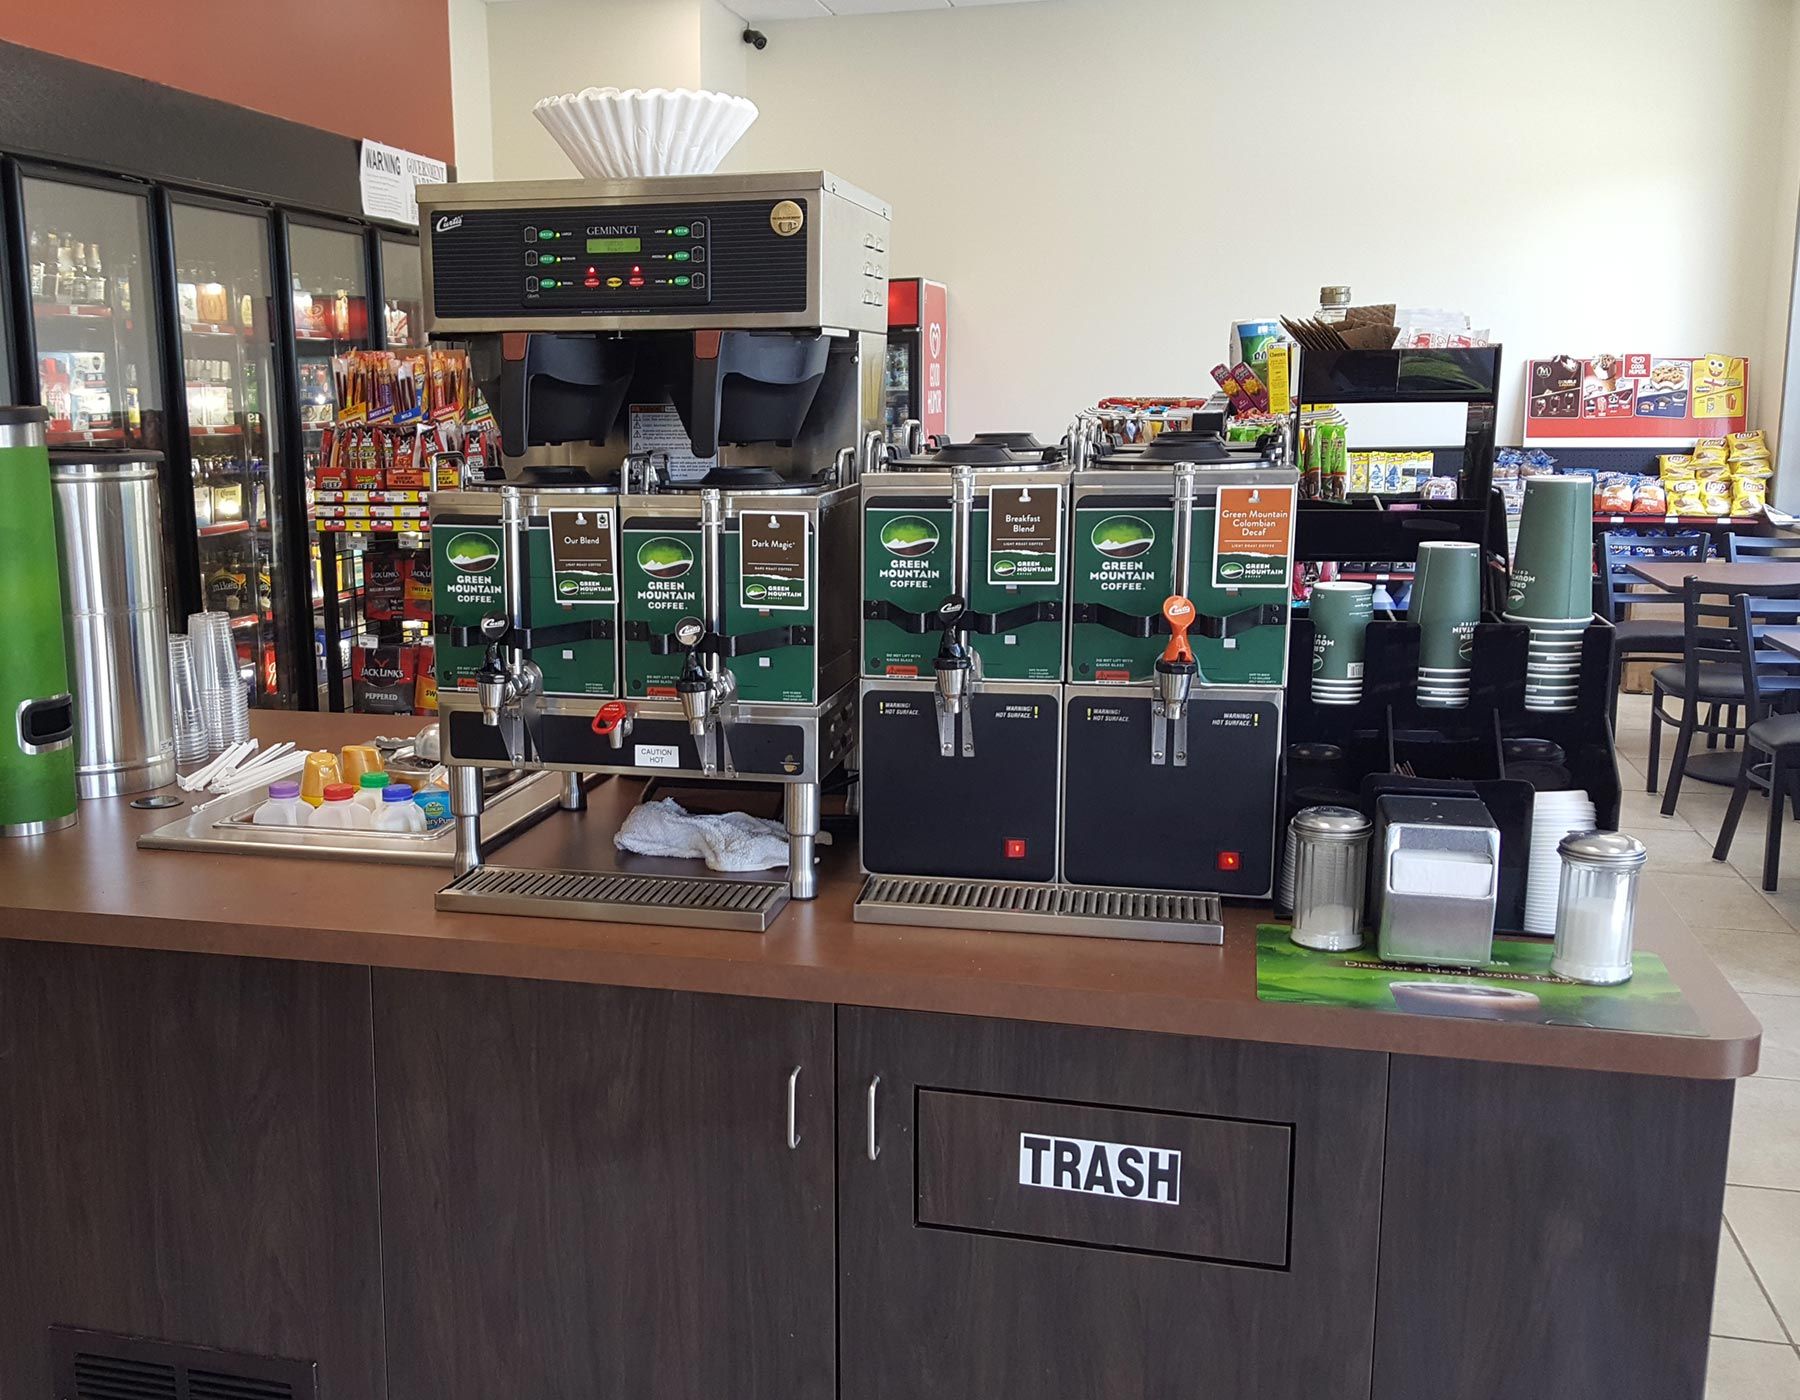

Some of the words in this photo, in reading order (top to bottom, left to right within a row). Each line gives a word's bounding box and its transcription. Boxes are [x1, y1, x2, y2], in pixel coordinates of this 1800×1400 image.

[366, 148, 401, 175] WARNING
[406, 158, 444, 182] GOVERNMENT
[436, 216, 462, 232] Curtis
[433, 406, 455, 417] ORIGINAL
[1006, 514, 1040, 523] Breakfast
[1222, 510, 1247, 518] Green
[1249, 510, 1288, 518] Mountain
[1232, 519, 1276, 527] Colombian
[1013, 525, 1035, 533] Blend
[1242, 528, 1267, 536] Decaf
[752, 539, 769, 548] Dark
[891, 560, 929, 568] GREEN
[1102, 562, 1144, 570] GREEN
[880, 570, 940, 579] MOUNTAIN
[1090, 571, 1155, 581] MOUNTAIN
[457, 575, 492, 584] GREEN
[448, 585, 502, 594] MOUNTAIN
[648, 582, 685, 590] GREEN
[638, 591, 695, 600] MOUNTAIN
[941, 603, 961, 613] Curtis
[1168, 605, 1190, 616] Curtis
[361, 667, 380, 678] JACK
[365, 692, 398, 700] PEPPERED
[1344, 960, 1408, 972] Discover
[1427, 967, 1462, 976] New
[1466, 969, 1530, 980] Favorite
[1024, 1136, 1179, 1201] TRASH
